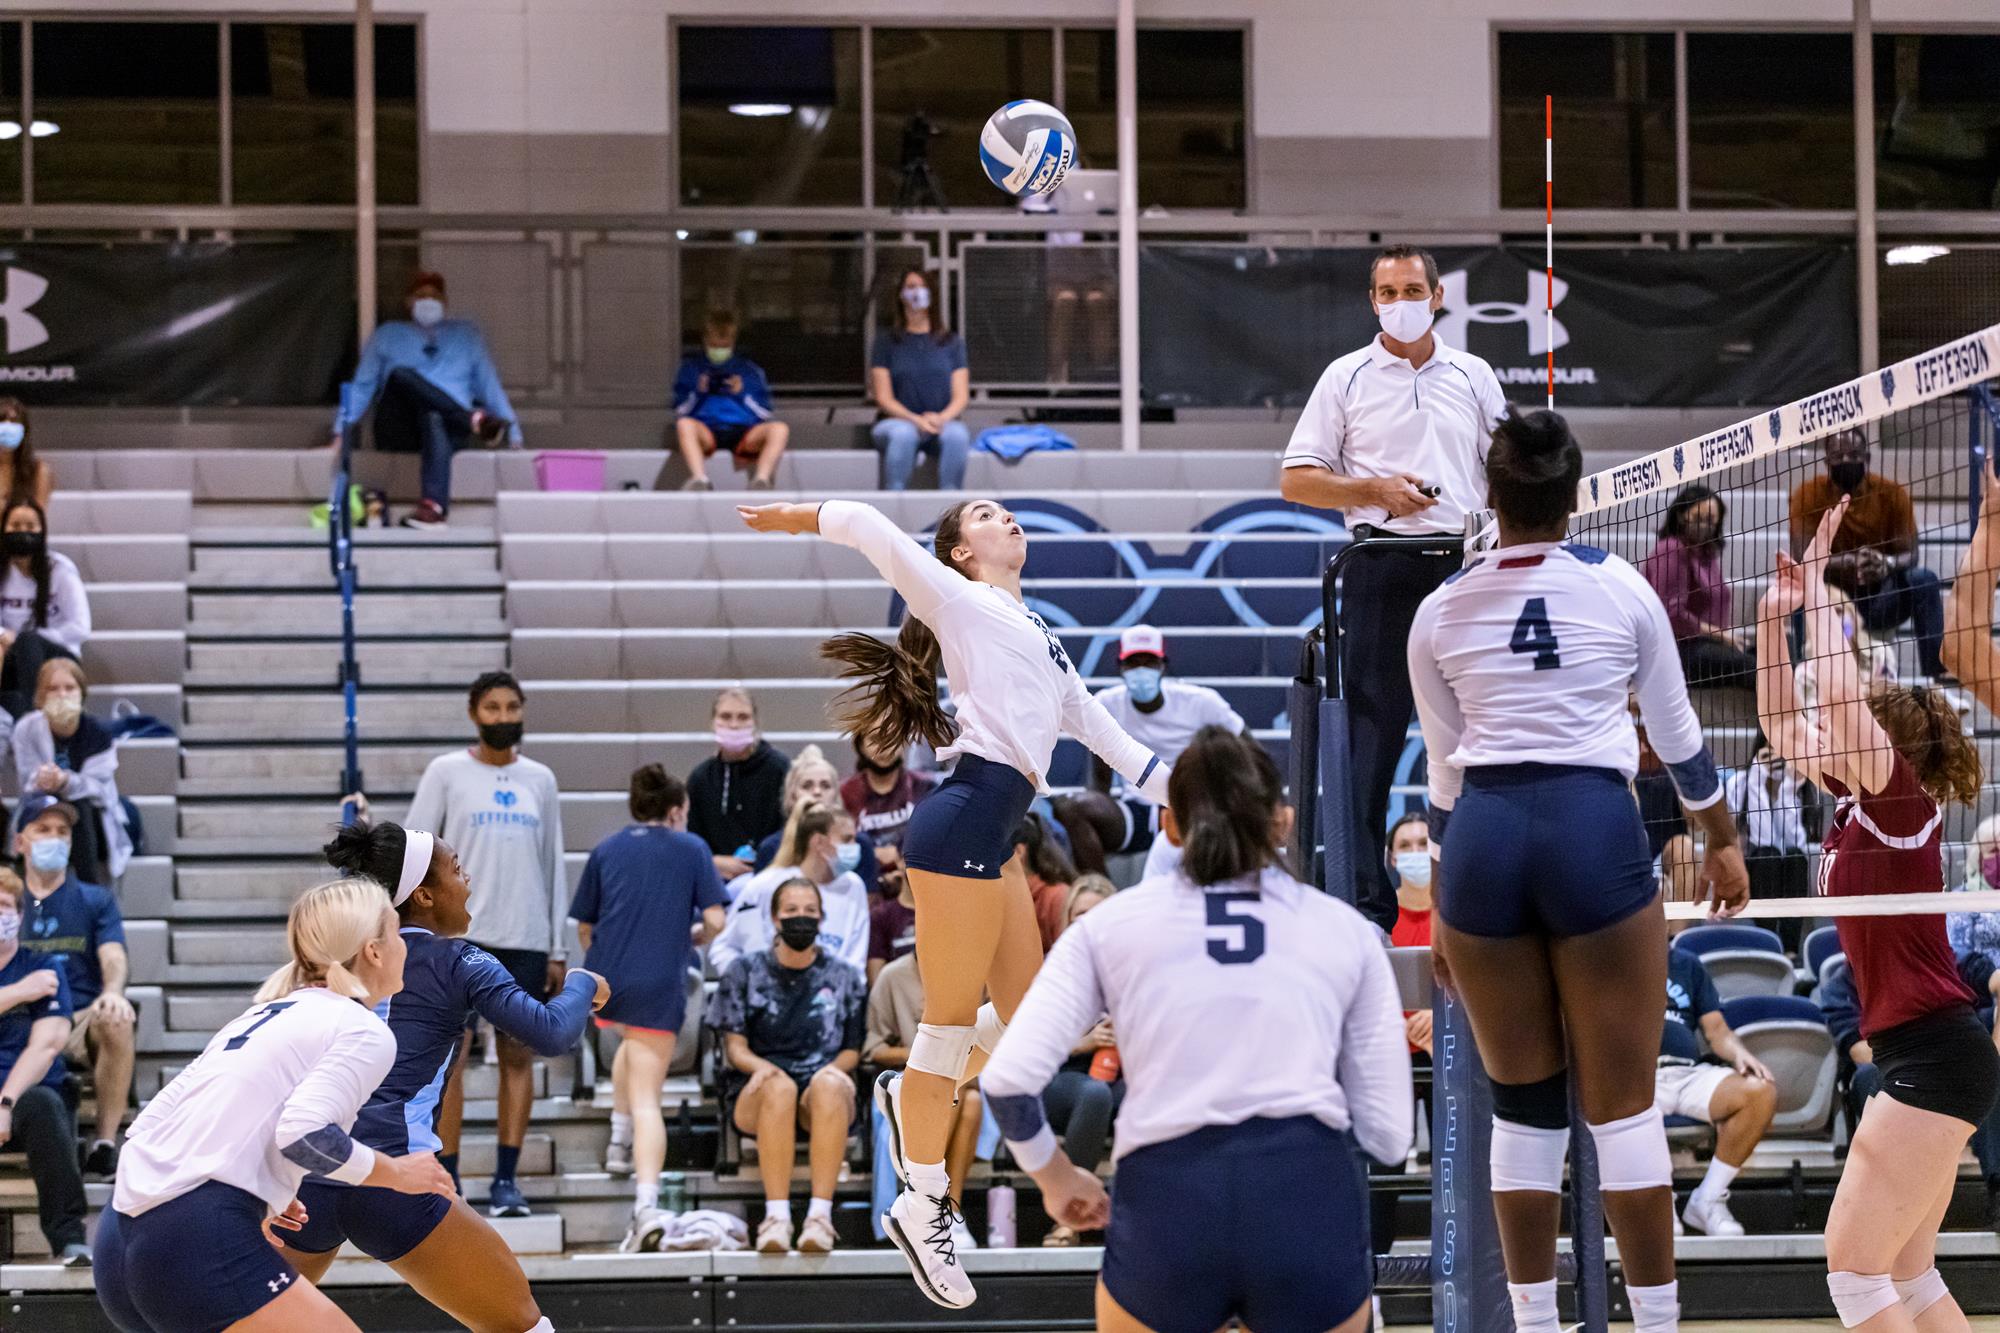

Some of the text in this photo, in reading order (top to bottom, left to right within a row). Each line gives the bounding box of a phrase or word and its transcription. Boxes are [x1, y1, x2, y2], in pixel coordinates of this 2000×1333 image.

[0, 366, 76, 381] MOUR
[1913, 336, 1990, 396] JEFFERSON
[1798, 383, 1864, 436] JEFFERSON
[1699, 423, 1754, 471] JEFFERSON
[1612, 458, 1662, 500] JEFFERSON
[1509, 597, 1561, 671] 4
[1204, 893, 1265, 965] 5
[222, 1000, 299, 1051] 7
